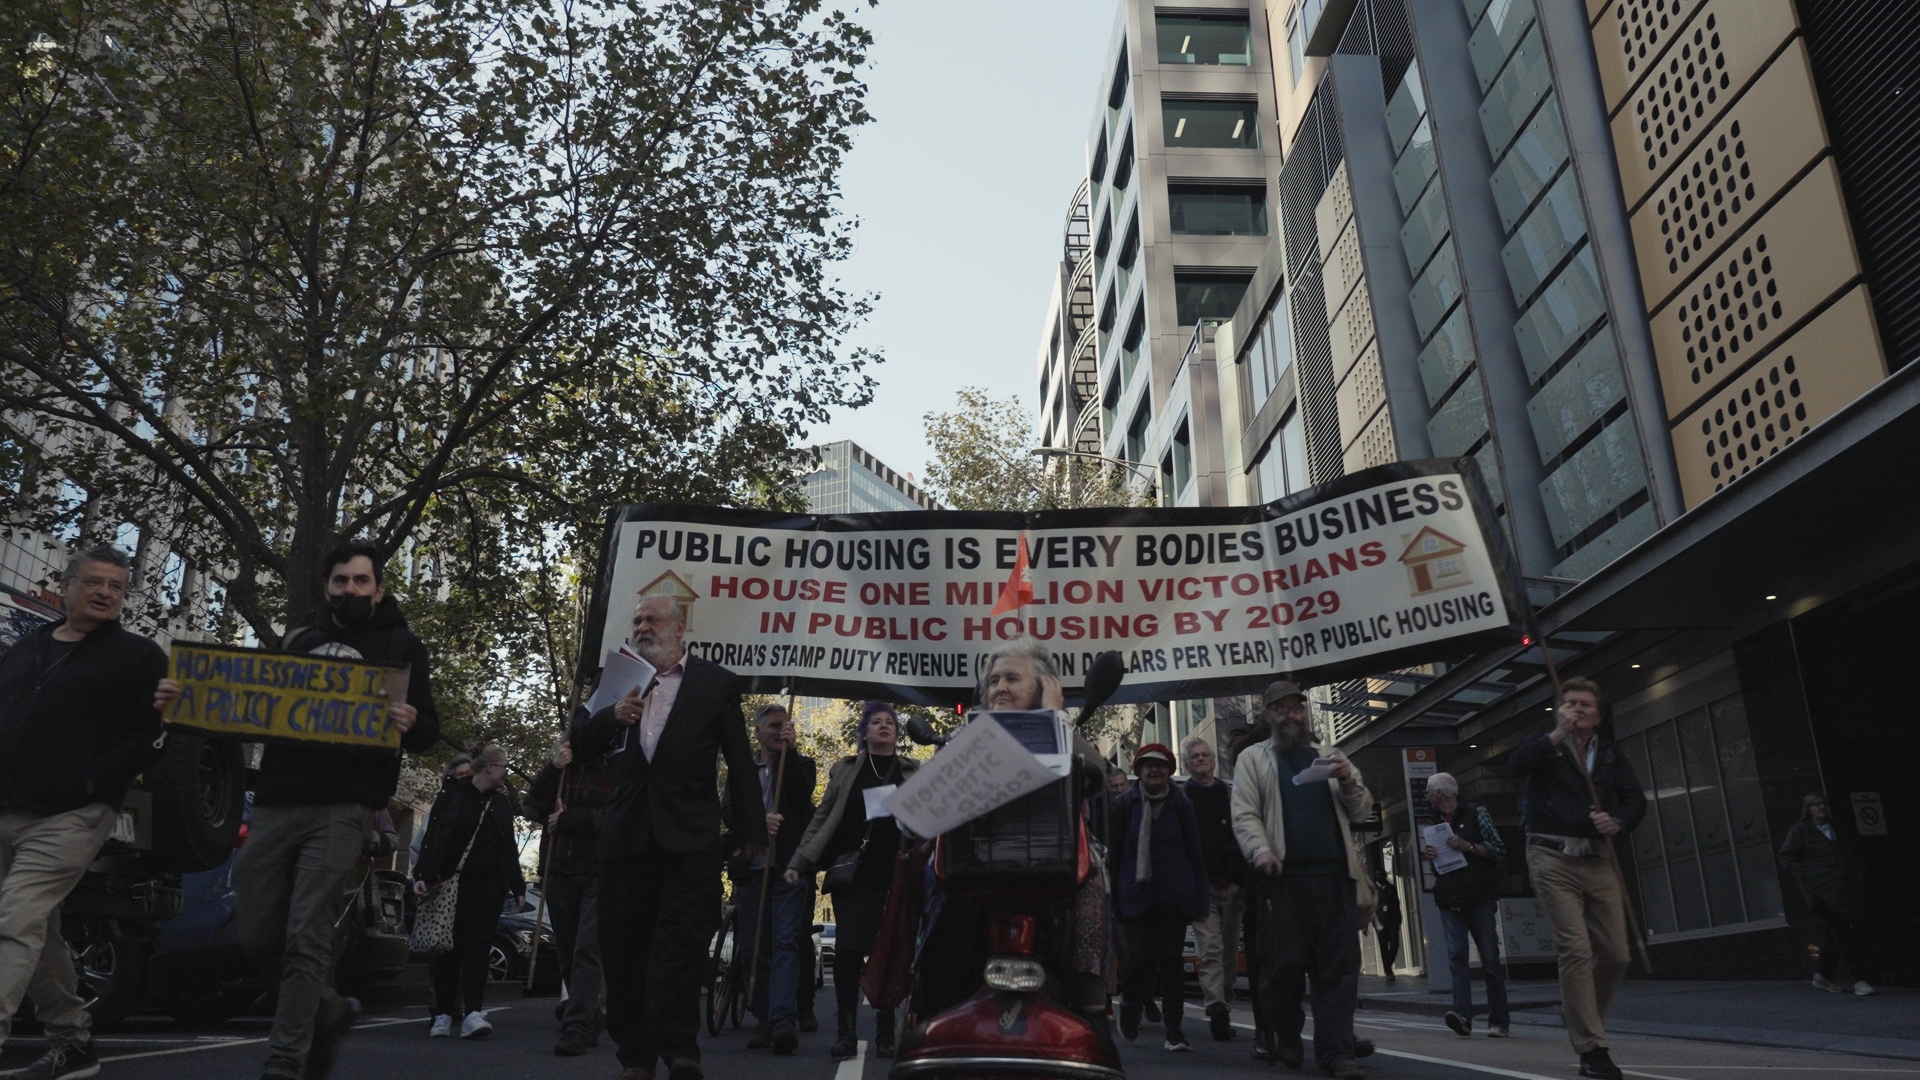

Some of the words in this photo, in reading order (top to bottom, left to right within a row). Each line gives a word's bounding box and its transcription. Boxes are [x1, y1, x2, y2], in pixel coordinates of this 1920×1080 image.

[635, 530, 772, 567] PUBLIC
[784, 537, 930, 571] HOUSING
[945, 537, 981, 570] IS
[996, 535, 1123, 570] EVERY
[1136, 530, 1264, 567] BODIES
[1275, 480, 1464, 555] BUSINESS
[710, 575, 848, 604] HOUSE
[860, 582, 931, 606] ONE
[945, 579, 1123, 606] MIION
[1138, 541, 1387, 602] VICTORIANS
[683, 641, 766, 667] CTORIA'S
[770, 644, 826, 669] STAMP
[830, 647, 882, 672] DUTY
[885, 652, 968, 677] REVENUE
[1082, 648, 1167, 676] DLARS
[1173, 645, 1212, 670] PER
[1217, 639, 1274, 670] YEAR)
[1279, 631, 1317, 661] FOR
[1321, 614, 1393, 653] PUBLIC
[1398, 591, 1495, 635] HOUSING
[760, 611, 797, 634] IN
[808, 612, 947, 641] PUBLIC
[963, 613, 1159, 641] HOUSING
[1174, 608, 1230, 636] BY
[1246, 590, 1341, 629] 2029
[176, 651, 354, 694] HOMELESSNESS
[172, 685, 196, 718] A
[205, 686, 283, 729] POLICY
[288, 697, 393, 743] CHOICE!
